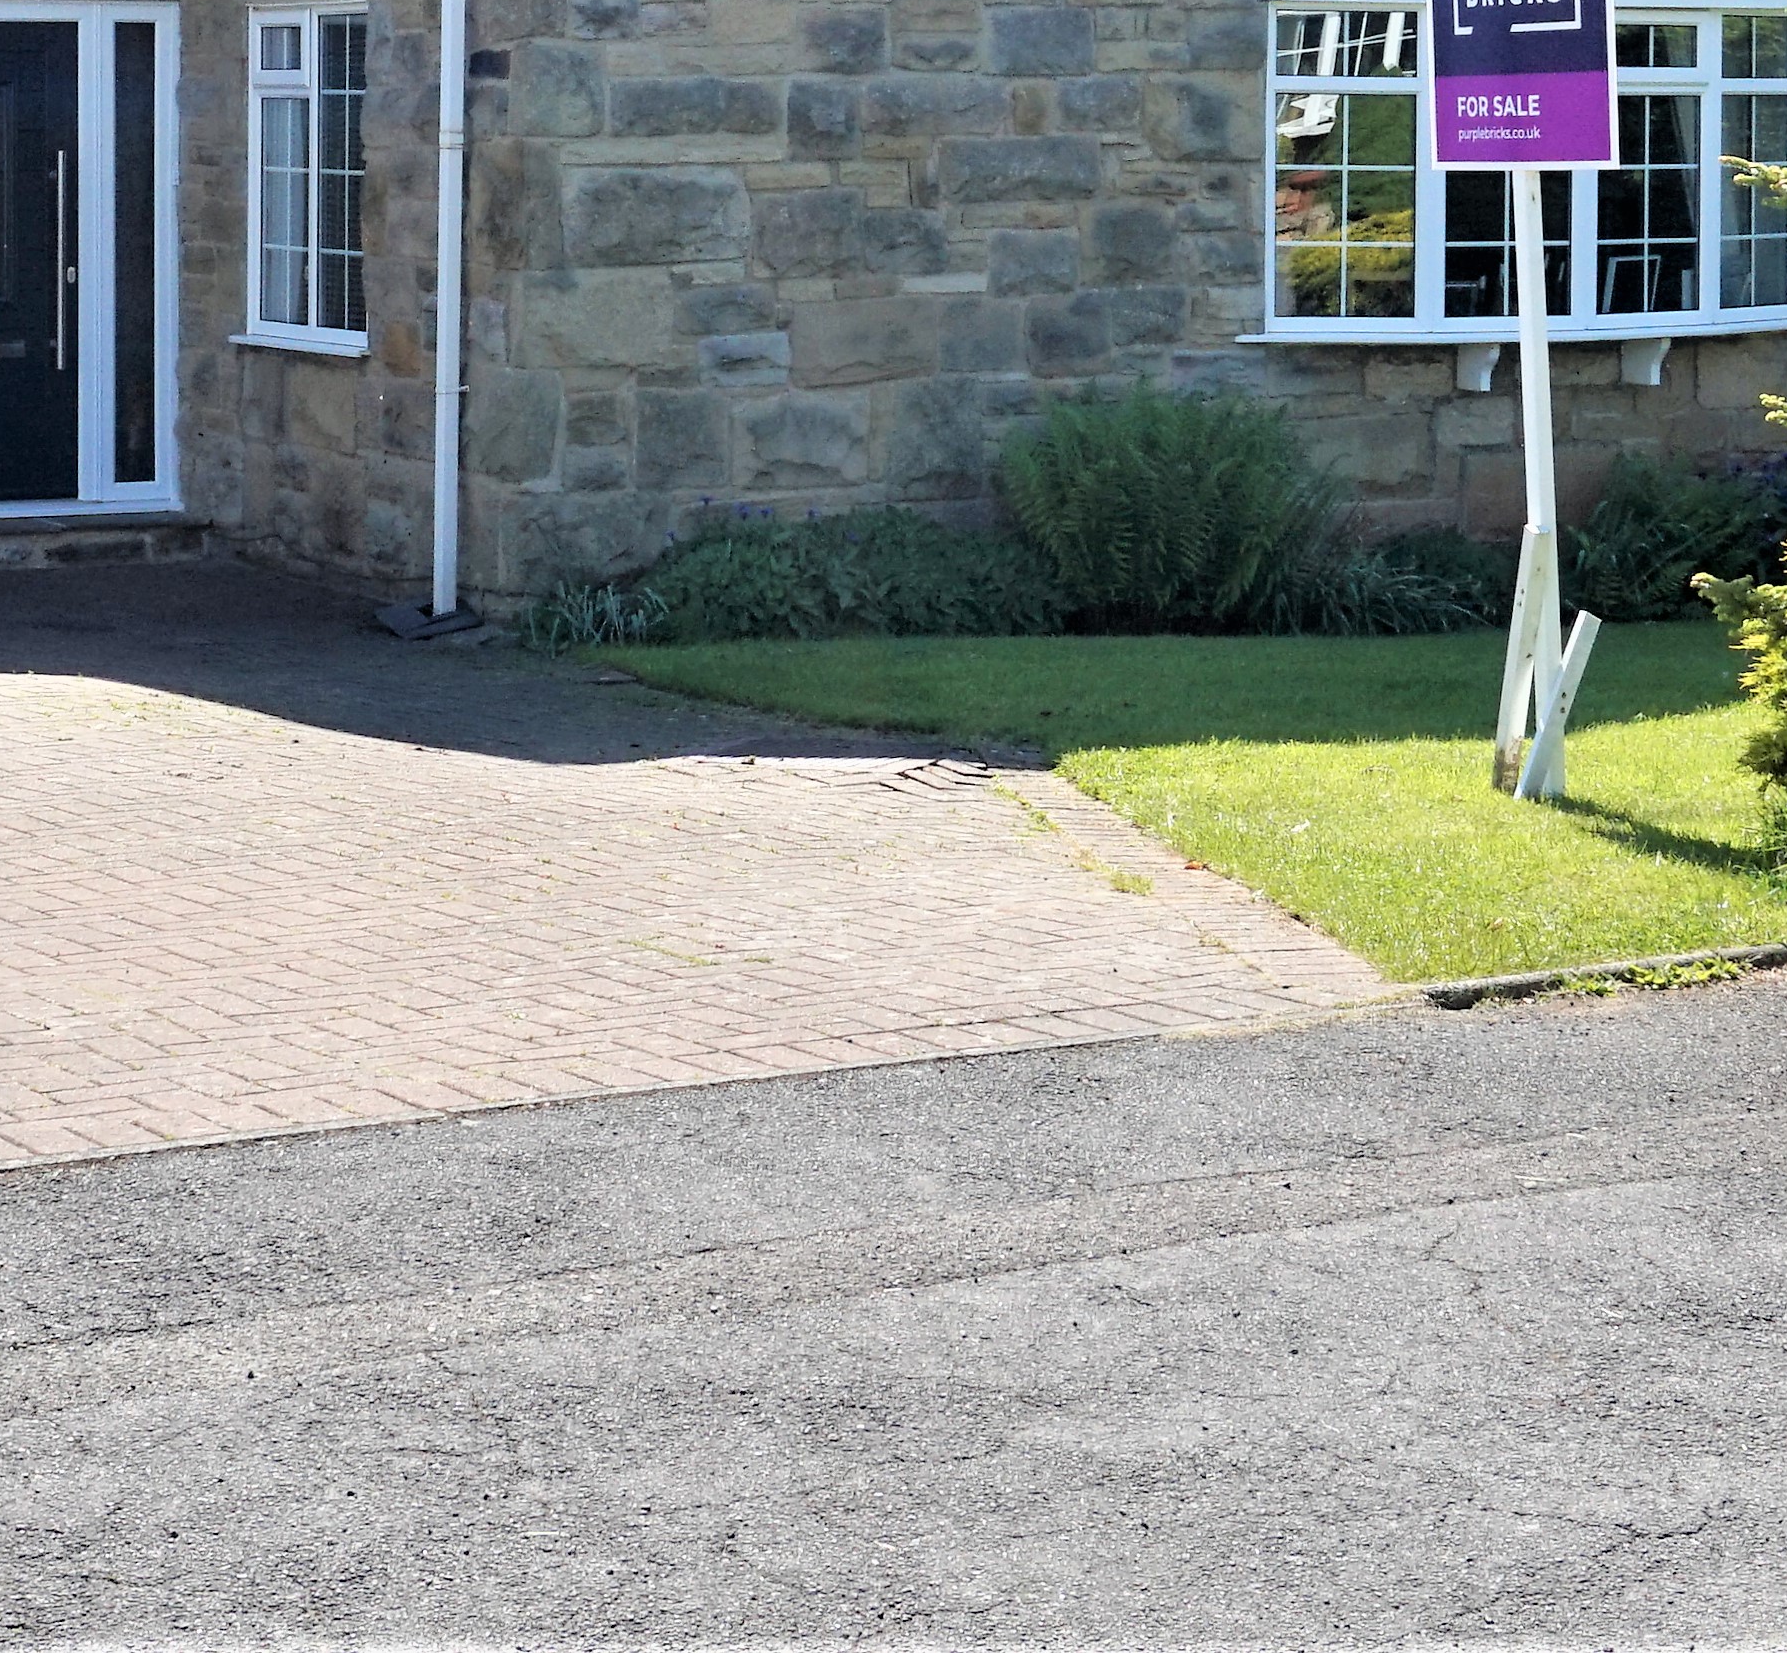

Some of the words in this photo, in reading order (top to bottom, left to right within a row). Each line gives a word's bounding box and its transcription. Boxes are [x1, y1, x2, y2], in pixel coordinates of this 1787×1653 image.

[1457, 96, 1489, 117] FOR
[1493, 95, 1541, 117] SALE
[1458, 126, 1541, 142] purplebricks.co.uk
